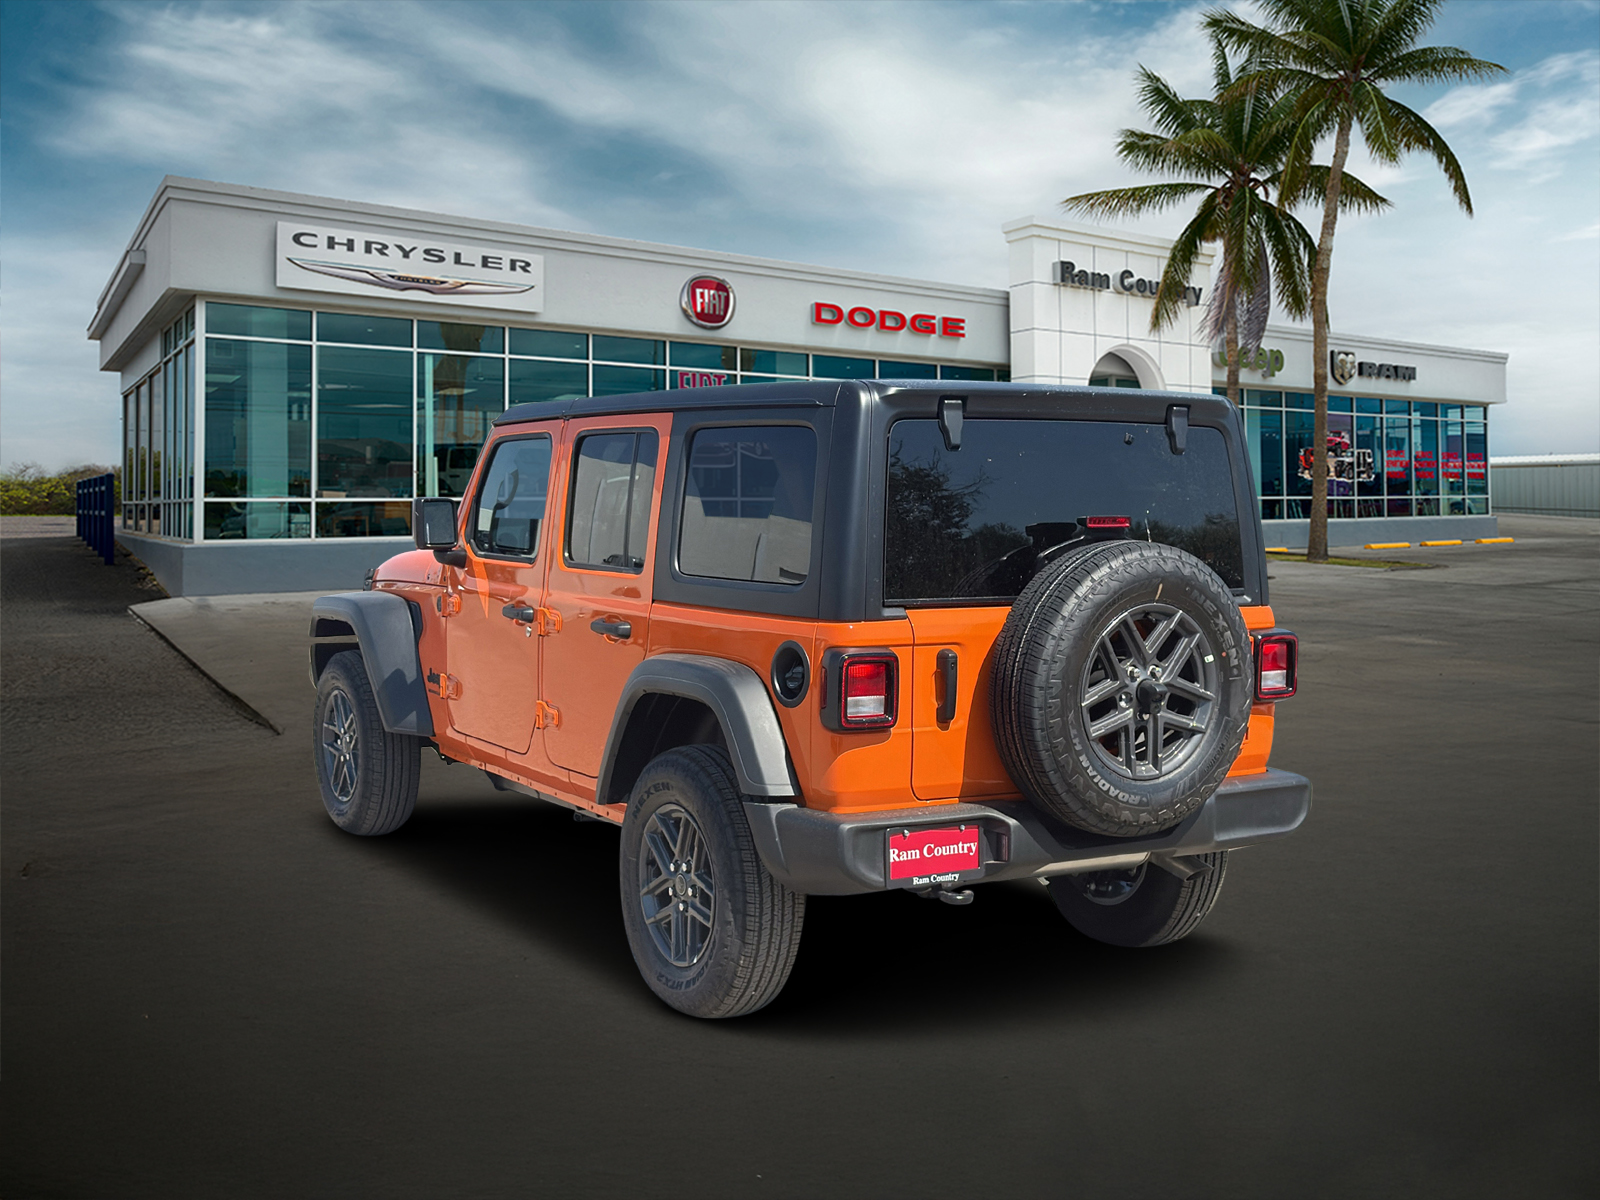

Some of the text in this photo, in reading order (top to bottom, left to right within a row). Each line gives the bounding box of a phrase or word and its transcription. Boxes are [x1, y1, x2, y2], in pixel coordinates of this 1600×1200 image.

[292, 232, 532, 273] CHRYSLER
[1057, 260, 1110, 290] Ram
[695, 288, 727, 316] FIAT
[812, 301, 966, 338] DODGE
[1217, 343, 1284, 377] eep
[1360, 362, 1416, 381] RAM
[1191, 589, 1239, 667] NEXEN
[1079, 754, 1141, 805] ROADIAN
[632, 781, 671, 820] NEXEN
[890, 841, 977, 862] Ram Country
[913, 873, 960, 885] Ram Country
